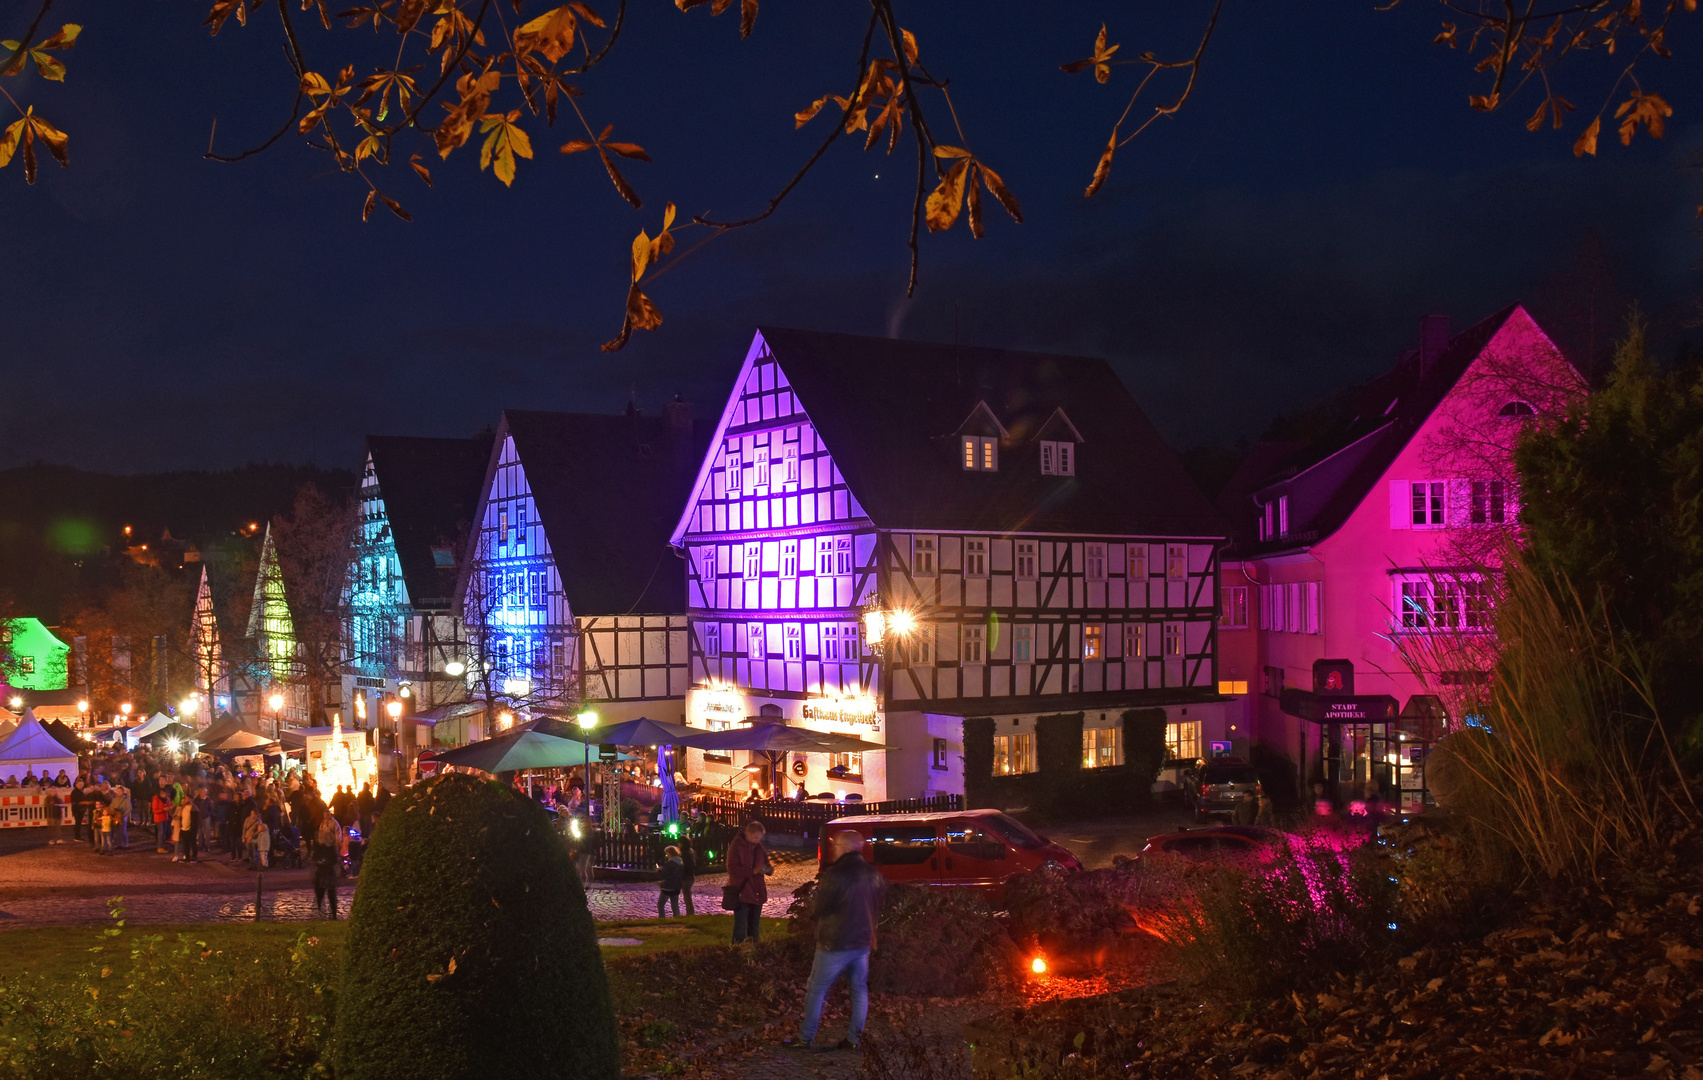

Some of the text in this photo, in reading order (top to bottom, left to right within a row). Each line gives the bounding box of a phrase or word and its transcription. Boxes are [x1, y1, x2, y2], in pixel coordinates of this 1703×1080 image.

[1331, 703, 1358, 711] STADT
[1325, 711, 1366, 719] APOTHEKE
[1212, 743, 1225, 758] P
